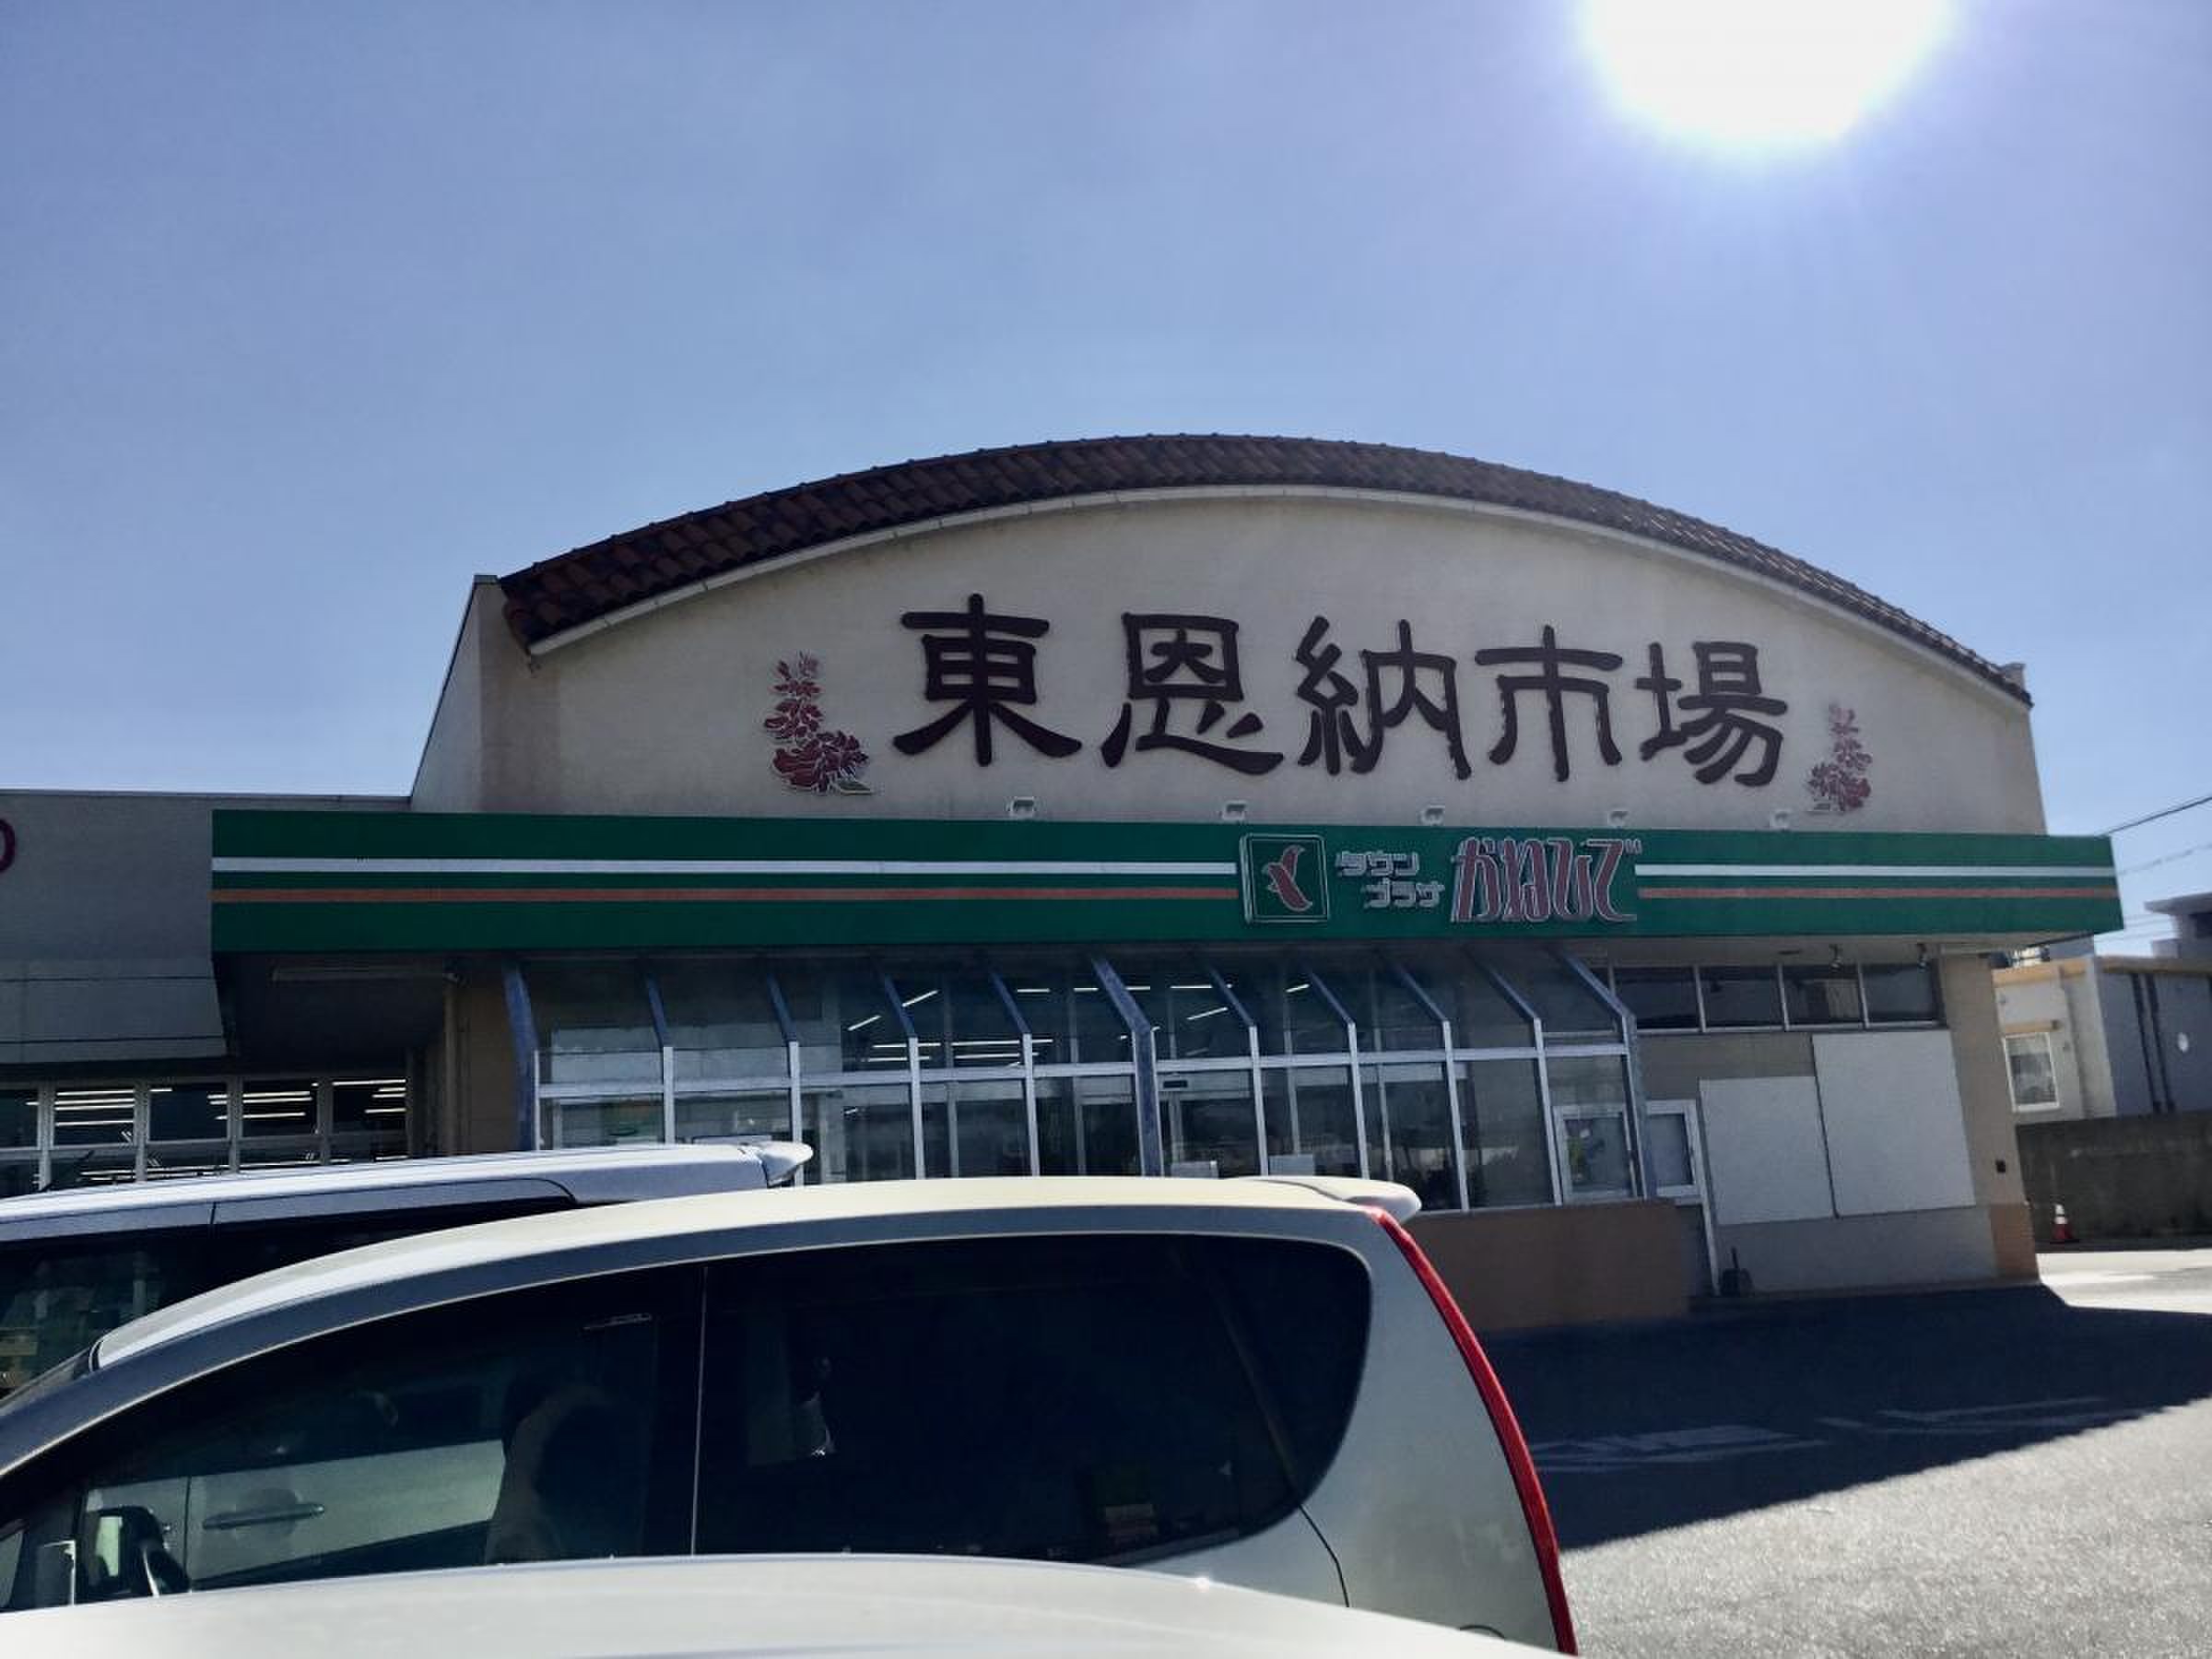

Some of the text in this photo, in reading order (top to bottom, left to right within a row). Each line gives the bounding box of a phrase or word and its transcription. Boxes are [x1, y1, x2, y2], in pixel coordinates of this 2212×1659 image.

[894, 592, 1789, 786] 東恩納市場
[1336, 851, 1420, 877] タウン
[1450, 837, 1643, 923] かねひで
